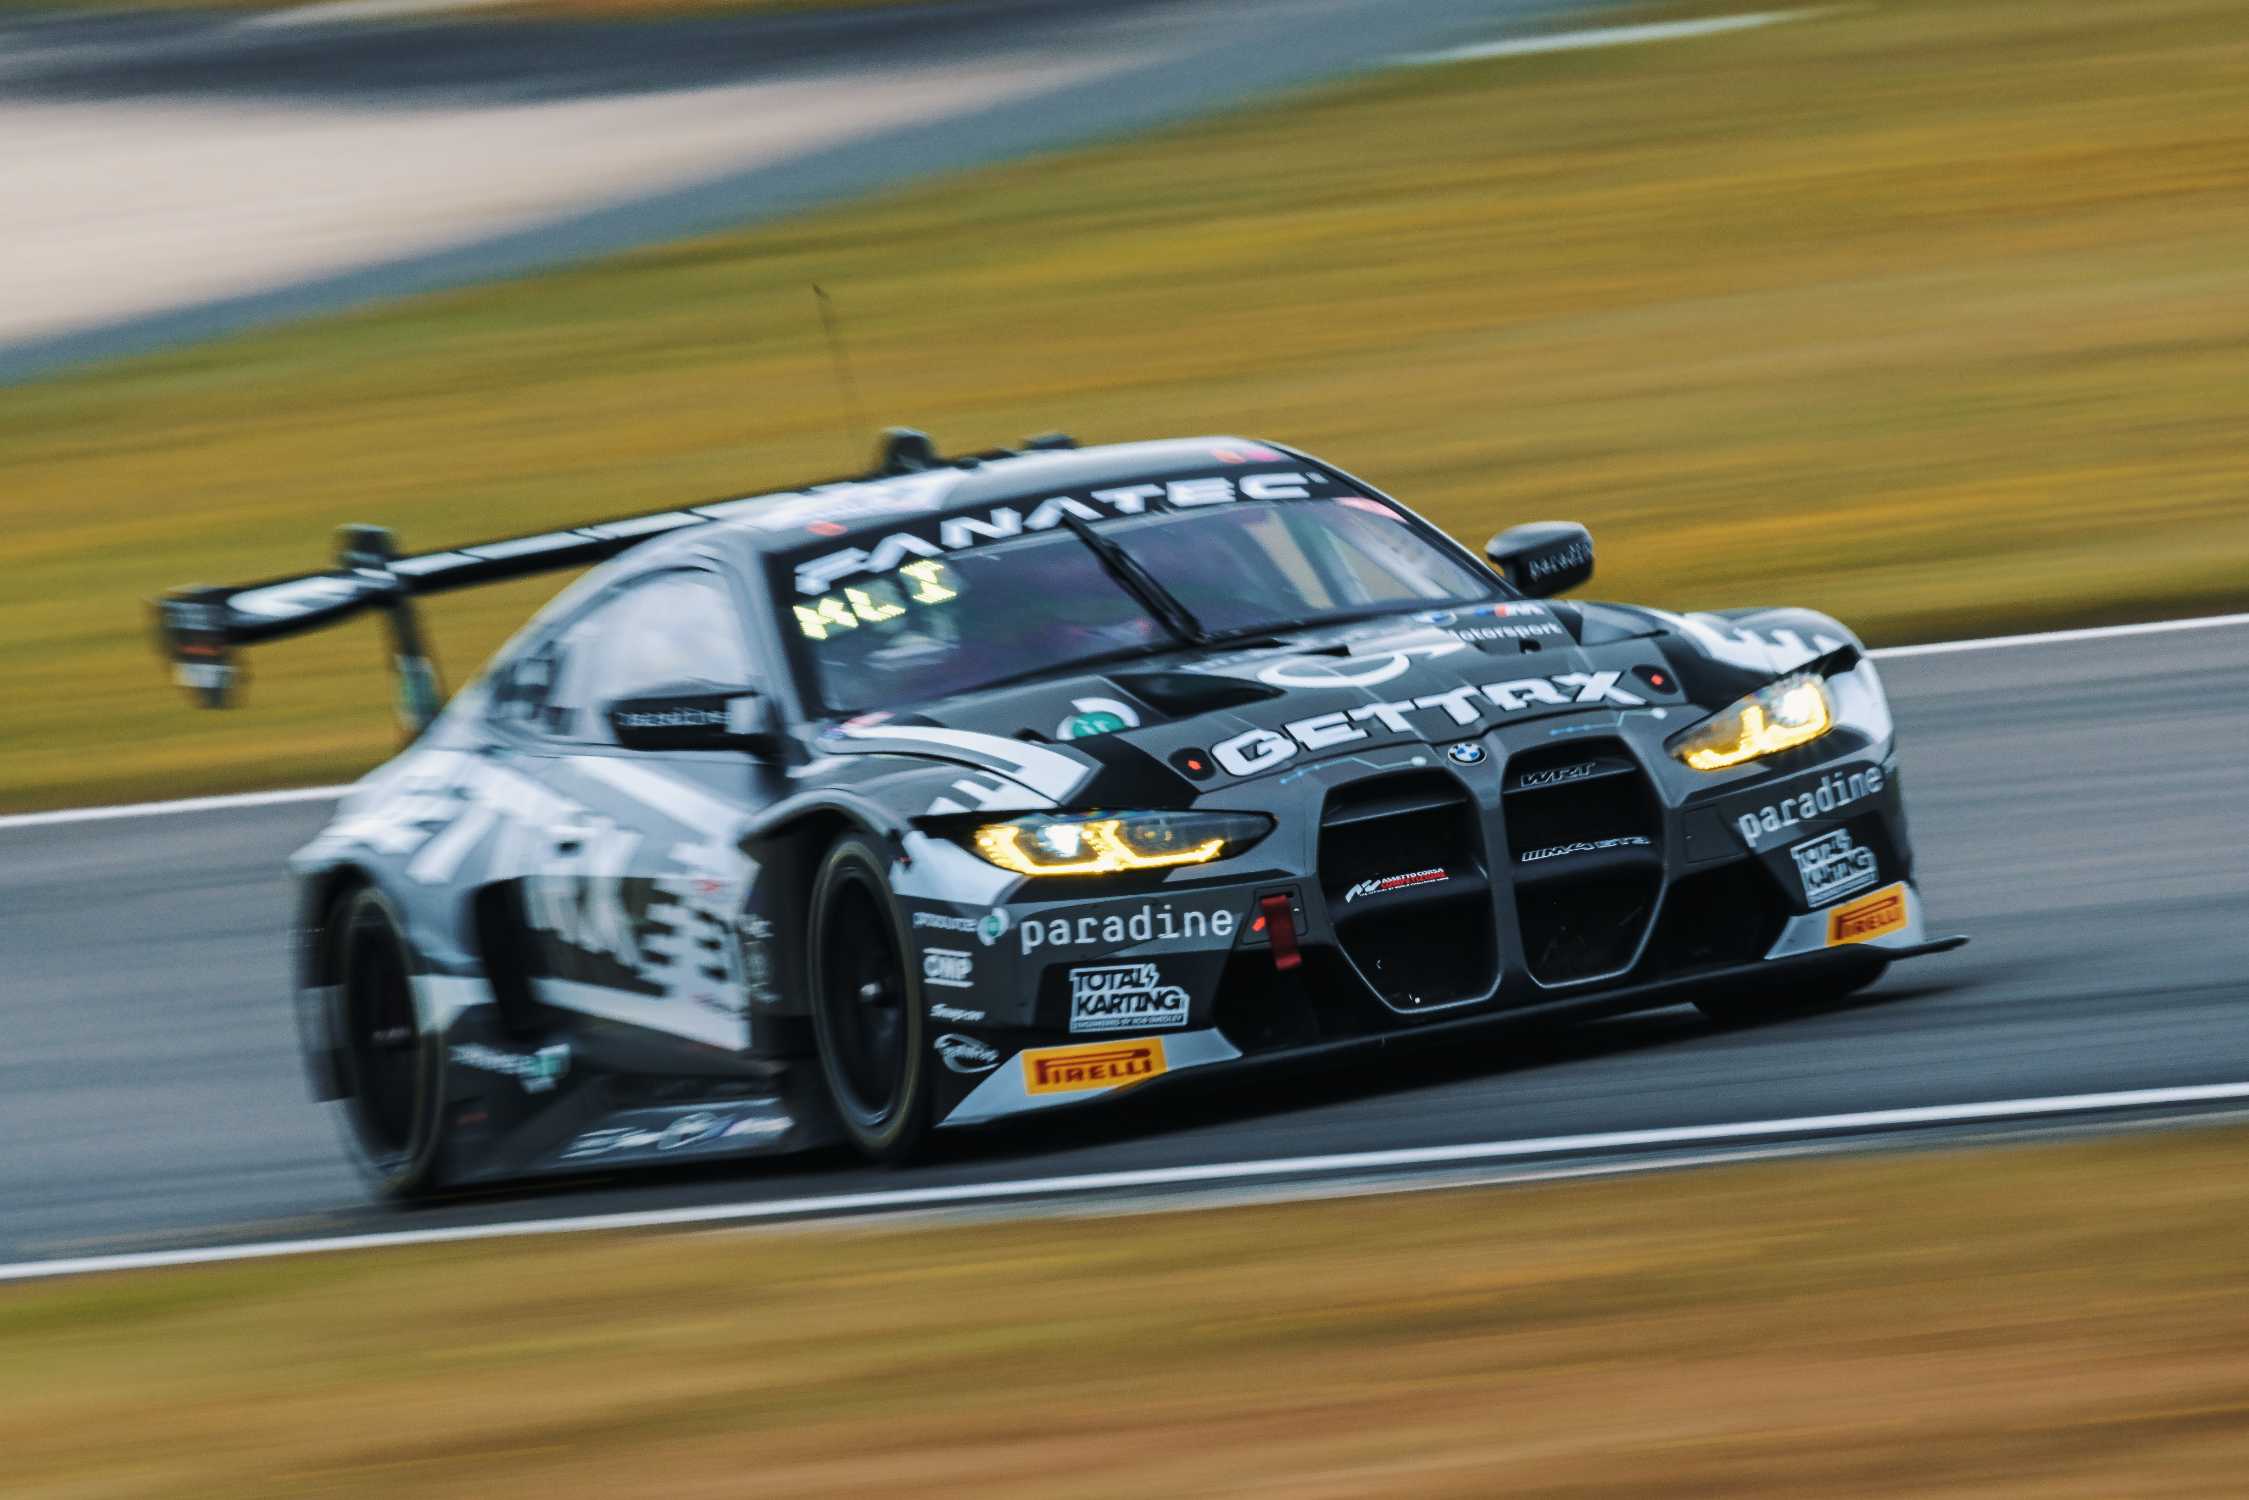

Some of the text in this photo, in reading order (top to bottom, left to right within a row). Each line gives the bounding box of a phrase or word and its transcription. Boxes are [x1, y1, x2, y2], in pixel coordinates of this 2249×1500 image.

[794, 472, 1311, 595] FANATEC
[1520, 762, 1597, 788] WRT
[1738, 766, 1884, 848] paradine
[1021, 904, 1234, 956] paradine
[1075, 968, 1147, 991] TOTAL
[1078, 989, 1183, 1016] KARTING
[1035, 1048, 1153, 1087] PIRELLI
